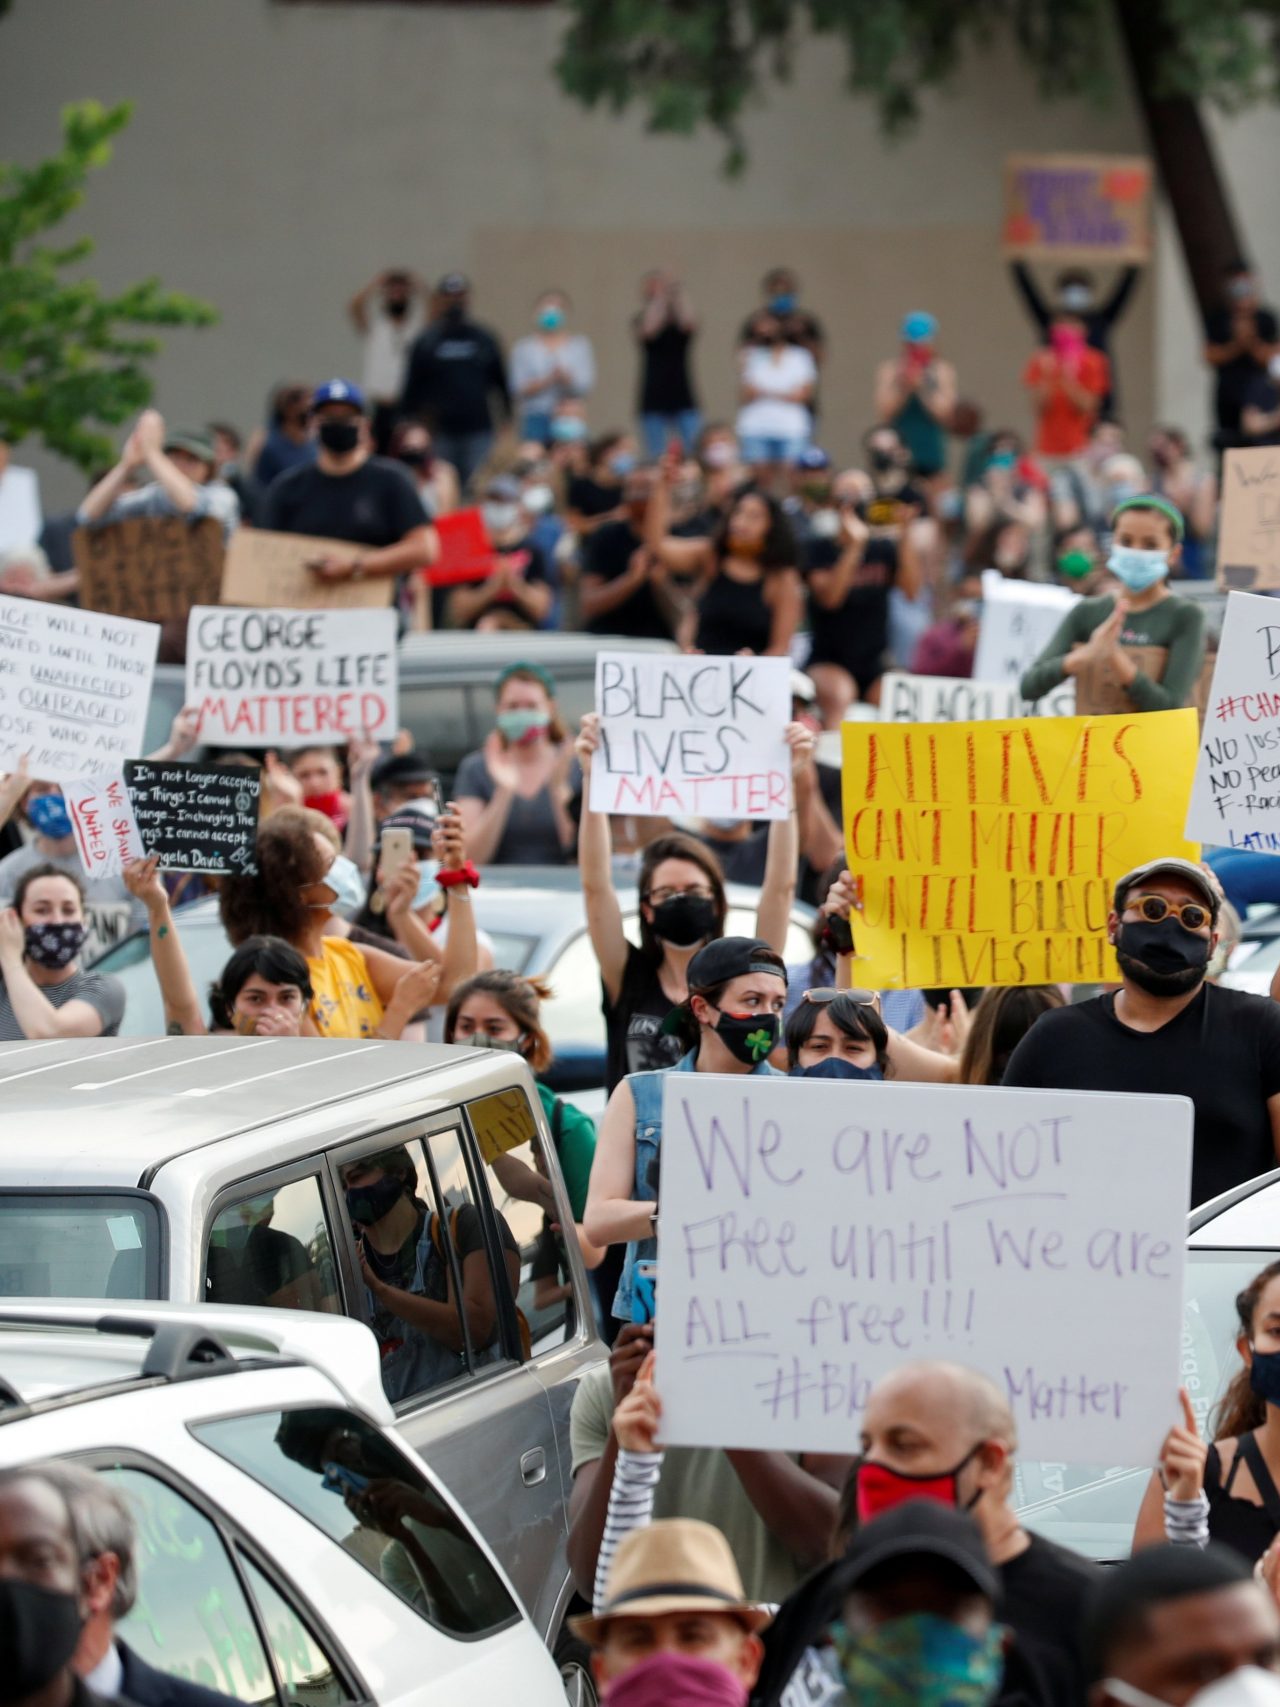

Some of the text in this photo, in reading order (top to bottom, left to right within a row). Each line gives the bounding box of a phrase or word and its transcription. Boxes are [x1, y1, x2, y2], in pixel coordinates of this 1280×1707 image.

[46, 615, 93, 637] WILL
[101, 627, 138, 648] NOT
[197, 614, 326, 653] GEORGE
[49, 644, 97, 666] UNTIL
[315, 653, 390, 688] LIFE
[30, 663, 132, 698] UNAFFECTED
[600, 661, 765, 719] BLACK
[49, 725, 88, 745] WHO
[197, 692, 389, 736] MATTERED
[600, 725, 747, 777] LIVES
[865, 723, 1145, 806] ALL LIVES
[105, 780, 125, 809] WE
[161, 769, 185, 783] not
[218, 774, 260, 797] accepting
[614, 771, 788, 814] MATTER
[852, 807, 1140, 878] CAN'T MATTER
[856, 873, 995, 933] UNTIL
[901, 933, 1032, 988] LIVES
[682, 1097, 1072, 1198] We are NOT
[830, 1219, 953, 1284] until
[1086, 1228, 1173, 1279] are
[685, 1296, 771, 1348] ALL
